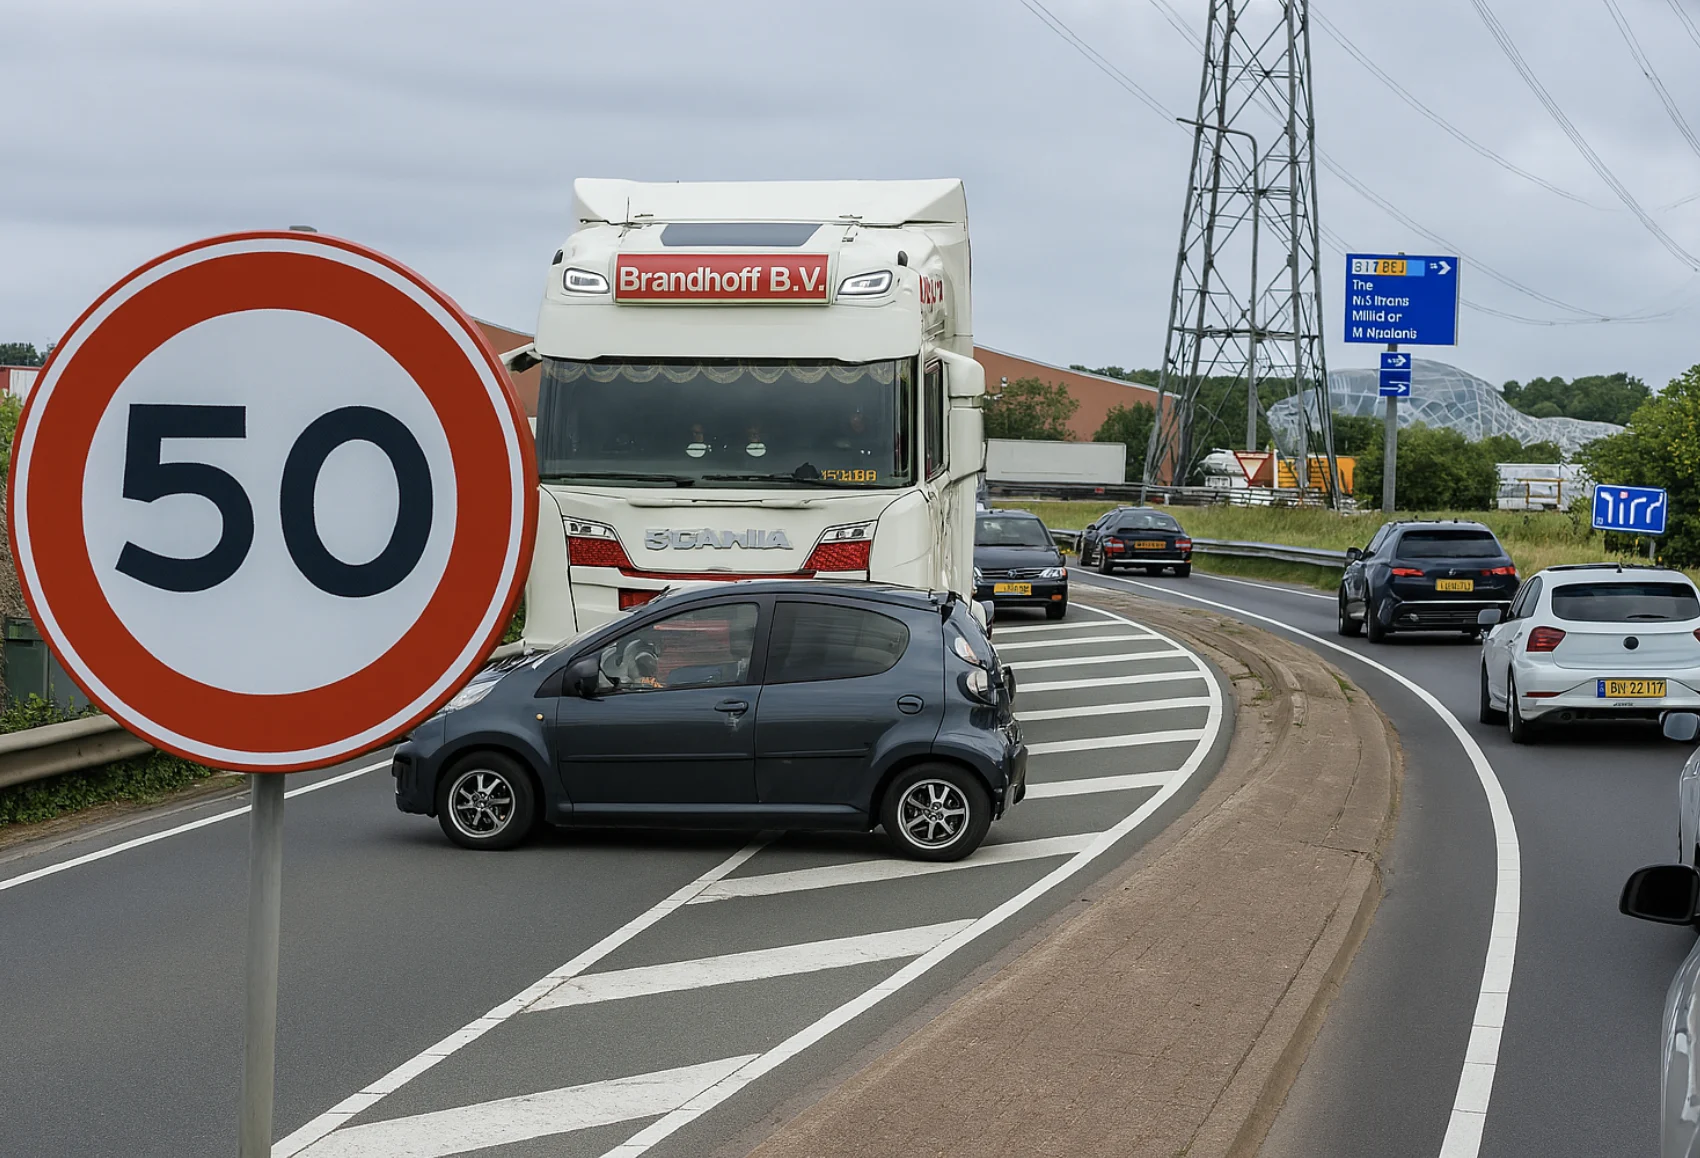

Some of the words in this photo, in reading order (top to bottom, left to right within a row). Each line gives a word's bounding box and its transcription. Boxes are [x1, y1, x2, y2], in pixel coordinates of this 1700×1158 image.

[619, 266, 762, 292] Brandhoff
[769, 266, 825, 291] B.V.
[1352, 279, 1374, 291] The
[115, 403, 434, 598] 50
[644, 528, 794, 551] SCANIA
[1630, 681, 1644, 694] 22
